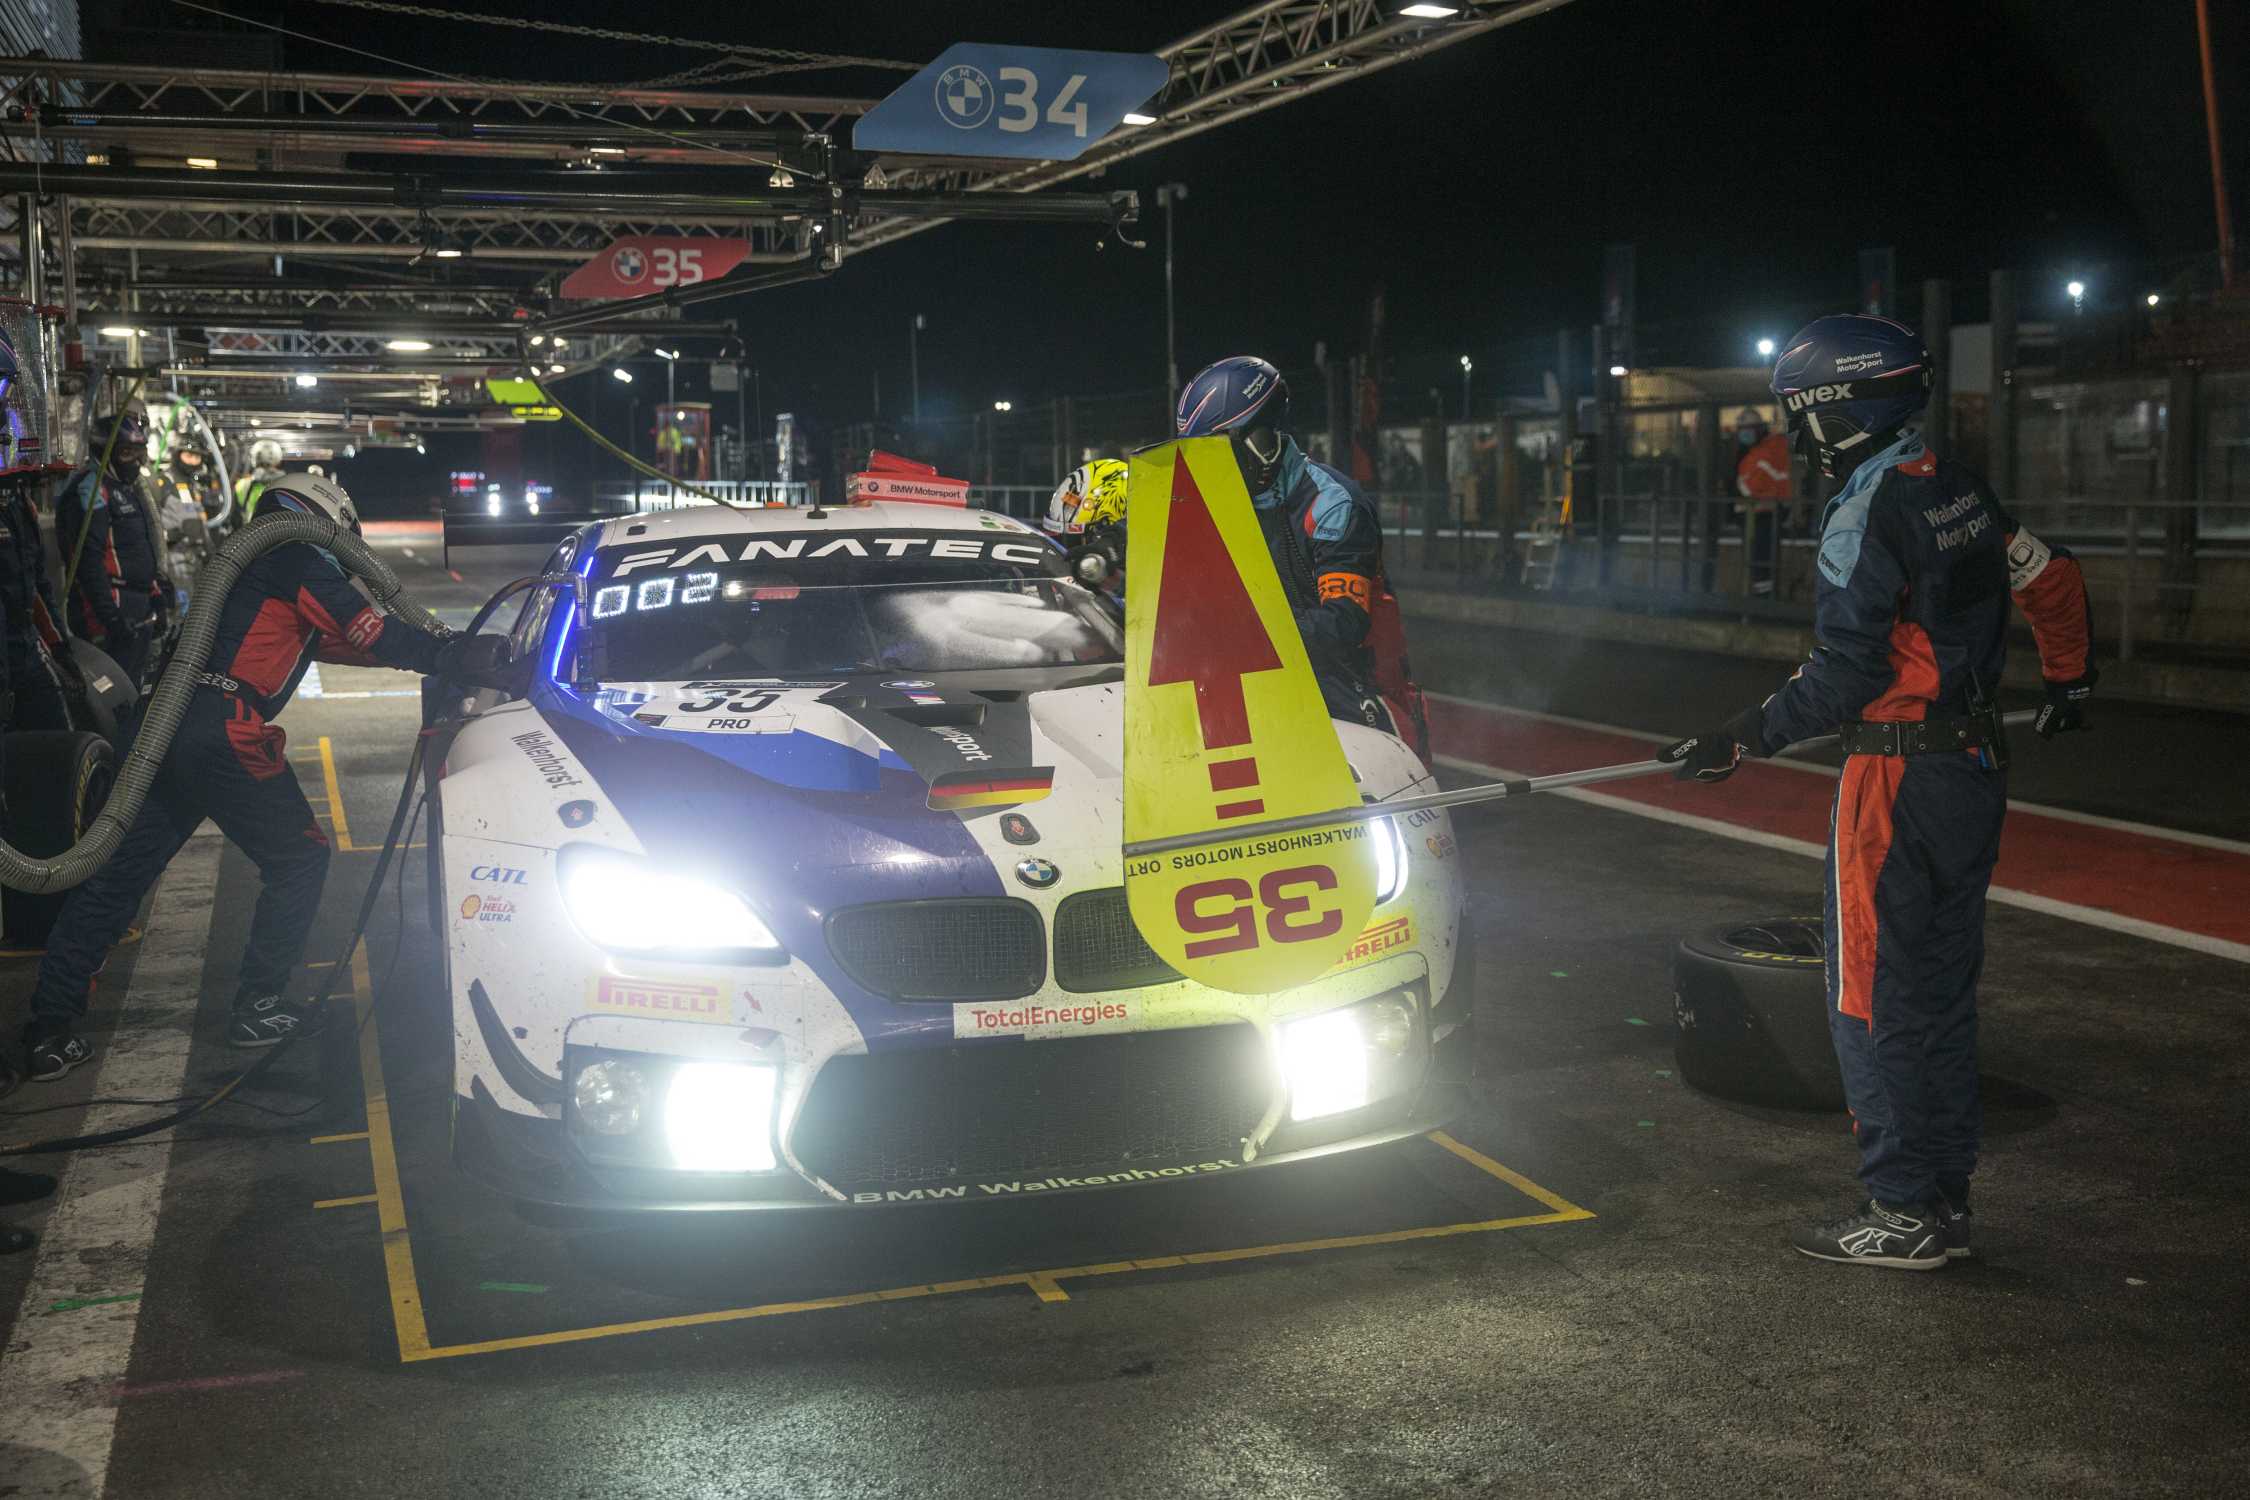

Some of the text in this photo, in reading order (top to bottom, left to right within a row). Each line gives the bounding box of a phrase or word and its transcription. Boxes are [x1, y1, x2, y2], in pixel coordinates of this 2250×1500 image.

[998, 67, 1088, 138] 34
[652, 248, 704, 287] 35
[1787, 383, 1854, 412] uvex
[890, 484, 961, 499] BMW Motorsport
[612, 538, 1044, 578] FANATEC
[592, 572, 719, 619] 002
[678, 689, 792, 713] 35
[707, 718, 752, 729] PRO
[511, 730, 583, 789] Walkenhorst
[1247, 825, 1367, 857] WALKENHORST
[470, 865, 529, 885] CATL
[480, 912, 512, 922] ULTRA
[482, 902, 516, 913] HELIX
[1174, 864, 1343, 960] 35
[597, 977, 719, 1013] PIRELLI
[971, 1003, 1127, 1029] TotalEnergies
[853, 1158, 1239, 1204] BMW Walkenhorst
